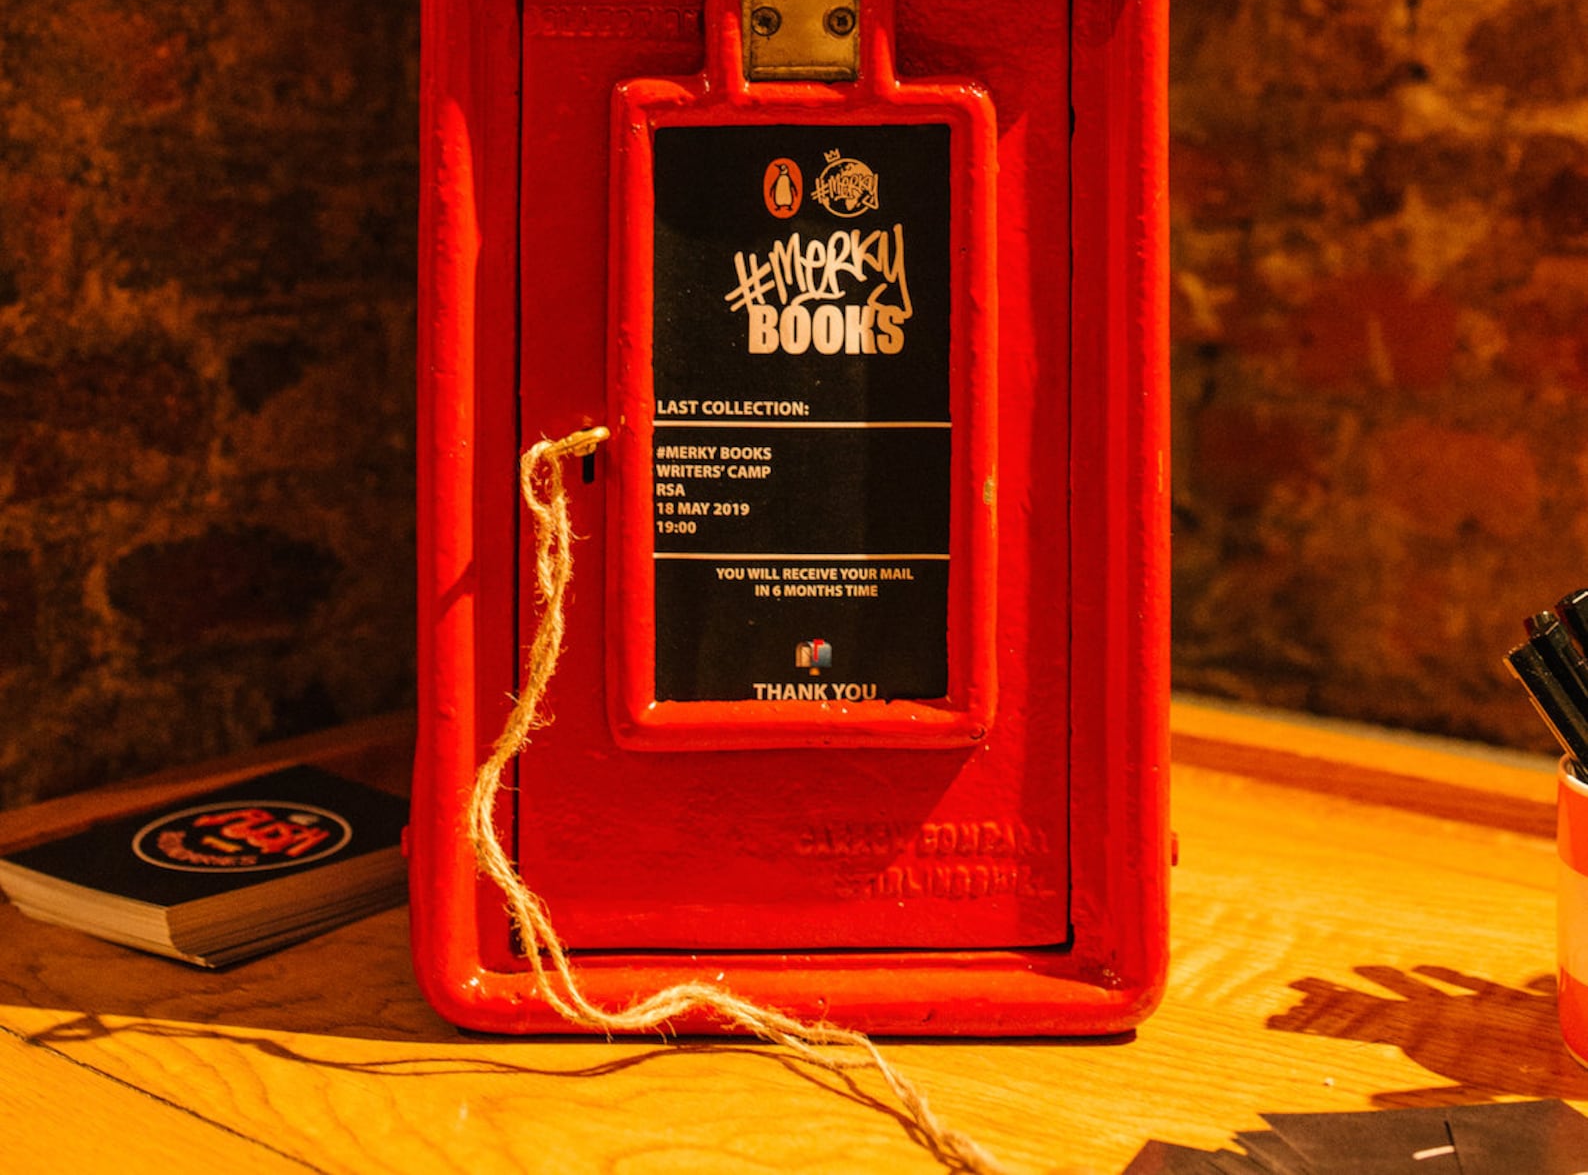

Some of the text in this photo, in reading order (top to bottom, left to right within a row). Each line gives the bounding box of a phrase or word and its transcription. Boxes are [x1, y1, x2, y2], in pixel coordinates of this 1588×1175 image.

[748, 304, 905, 355] BOOKS
[657, 399, 810, 416] LAST COLLECTION:
[656, 445, 772, 461] #MERKY BOOKS
[726, 464, 772, 479] CAMP
[656, 482, 686, 497] RSA
[656, 501, 750, 516] 18 MAY 2019
[656, 520, 697, 534] 19:00
[715, 567, 914, 581] YOU WILL RECEIVE YOUR MAIL
[754, 584, 878, 597] IN 6 MONTHS TIME
[753, 683, 878, 700] THANK YOU
